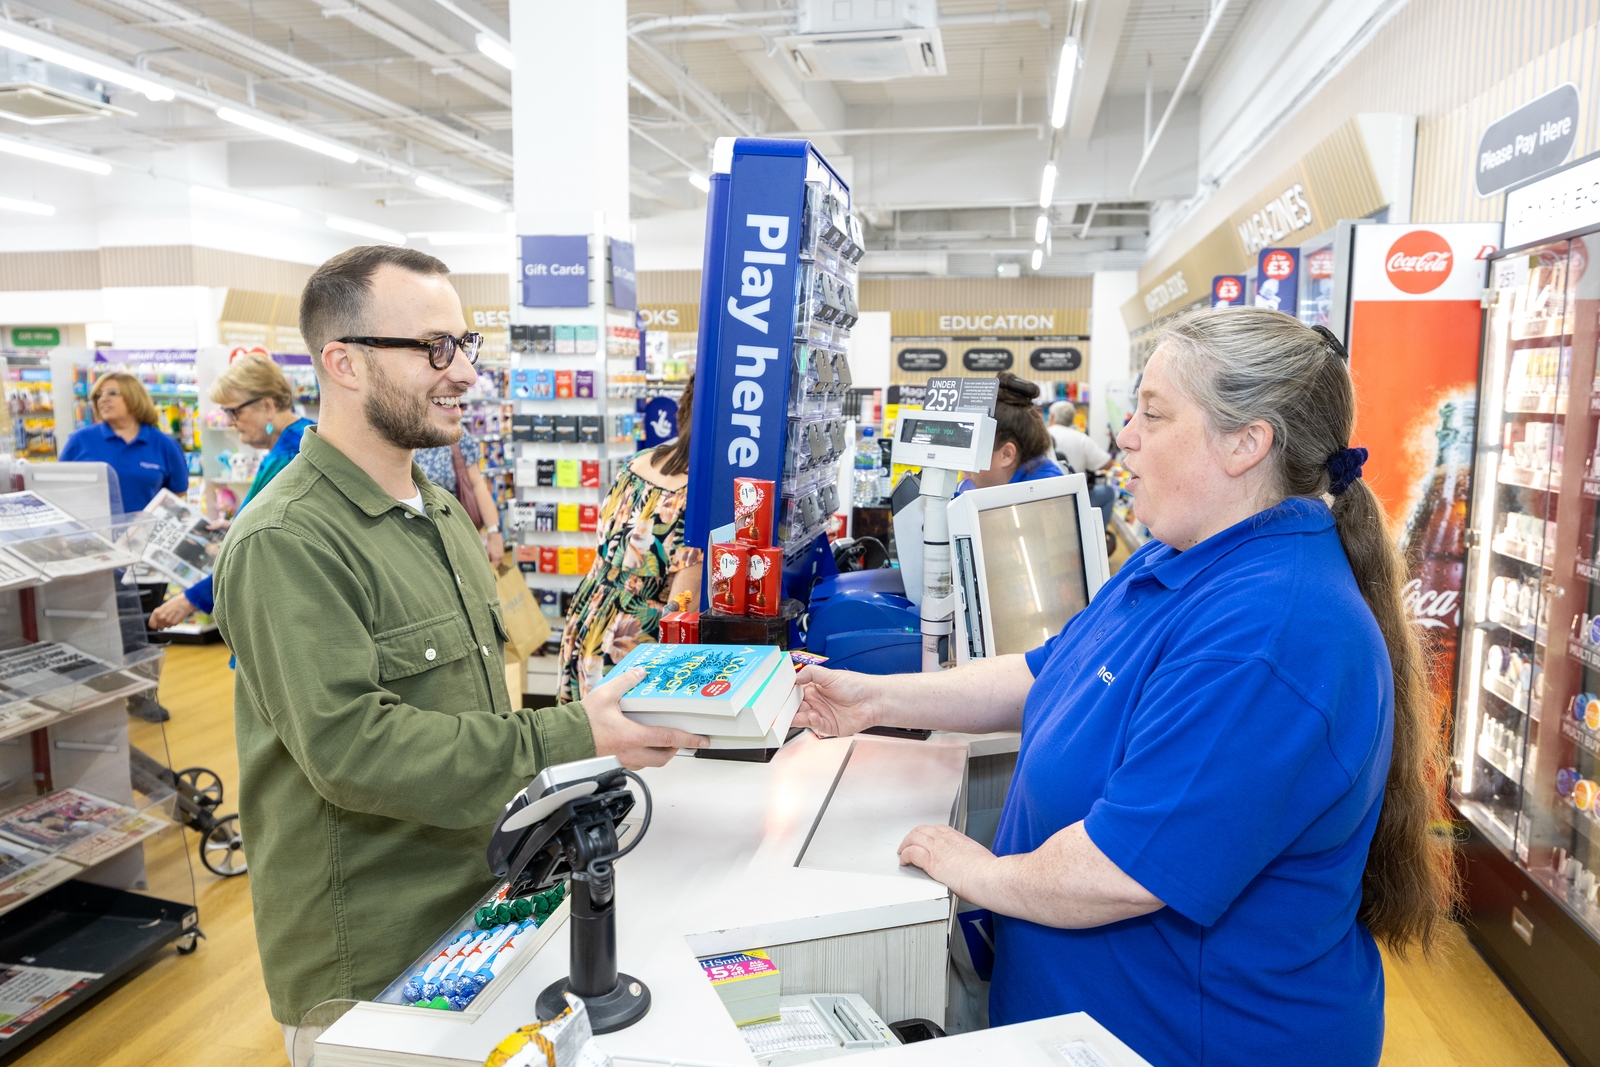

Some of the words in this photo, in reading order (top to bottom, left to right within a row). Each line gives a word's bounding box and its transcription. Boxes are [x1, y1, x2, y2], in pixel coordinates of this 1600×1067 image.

[1480, 144, 1514, 173] Please
[1514, 132, 1538, 157] Pay
[1539, 116, 1571, 146] Here
[1237, 183, 1312, 257] MAGAZINES
[524, 263, 548, 276] Gift
[550, 263, 586, 276] Cards
[727, 214, 789, 334] Play
[1267, 260, 1291, 275] £3
[1218, 288, 1238, 298] £3
[473, 310, 510, 328] BES
[639, 309, 680, 326] OKS
[939, 314, 1054, 332] EDUCATION
[128, 352, 154, 361] INFANT
[899, 386, 927, 398] Maga
[931, 380, 957, 389] UNDER
[728, 344, 779, 468] here
[925, 389, 958, 411] 25?
[924, 425, 941, 435] Thank
[1401, 578, 1460, 629] Coca
[740, 647, 755, 655] A
[660, 655, 706, 696] FROST
[715, 657, 745, 681] COU
[640, 676, 662, 696] AND
[700, 954, 751, 968] HSmith
